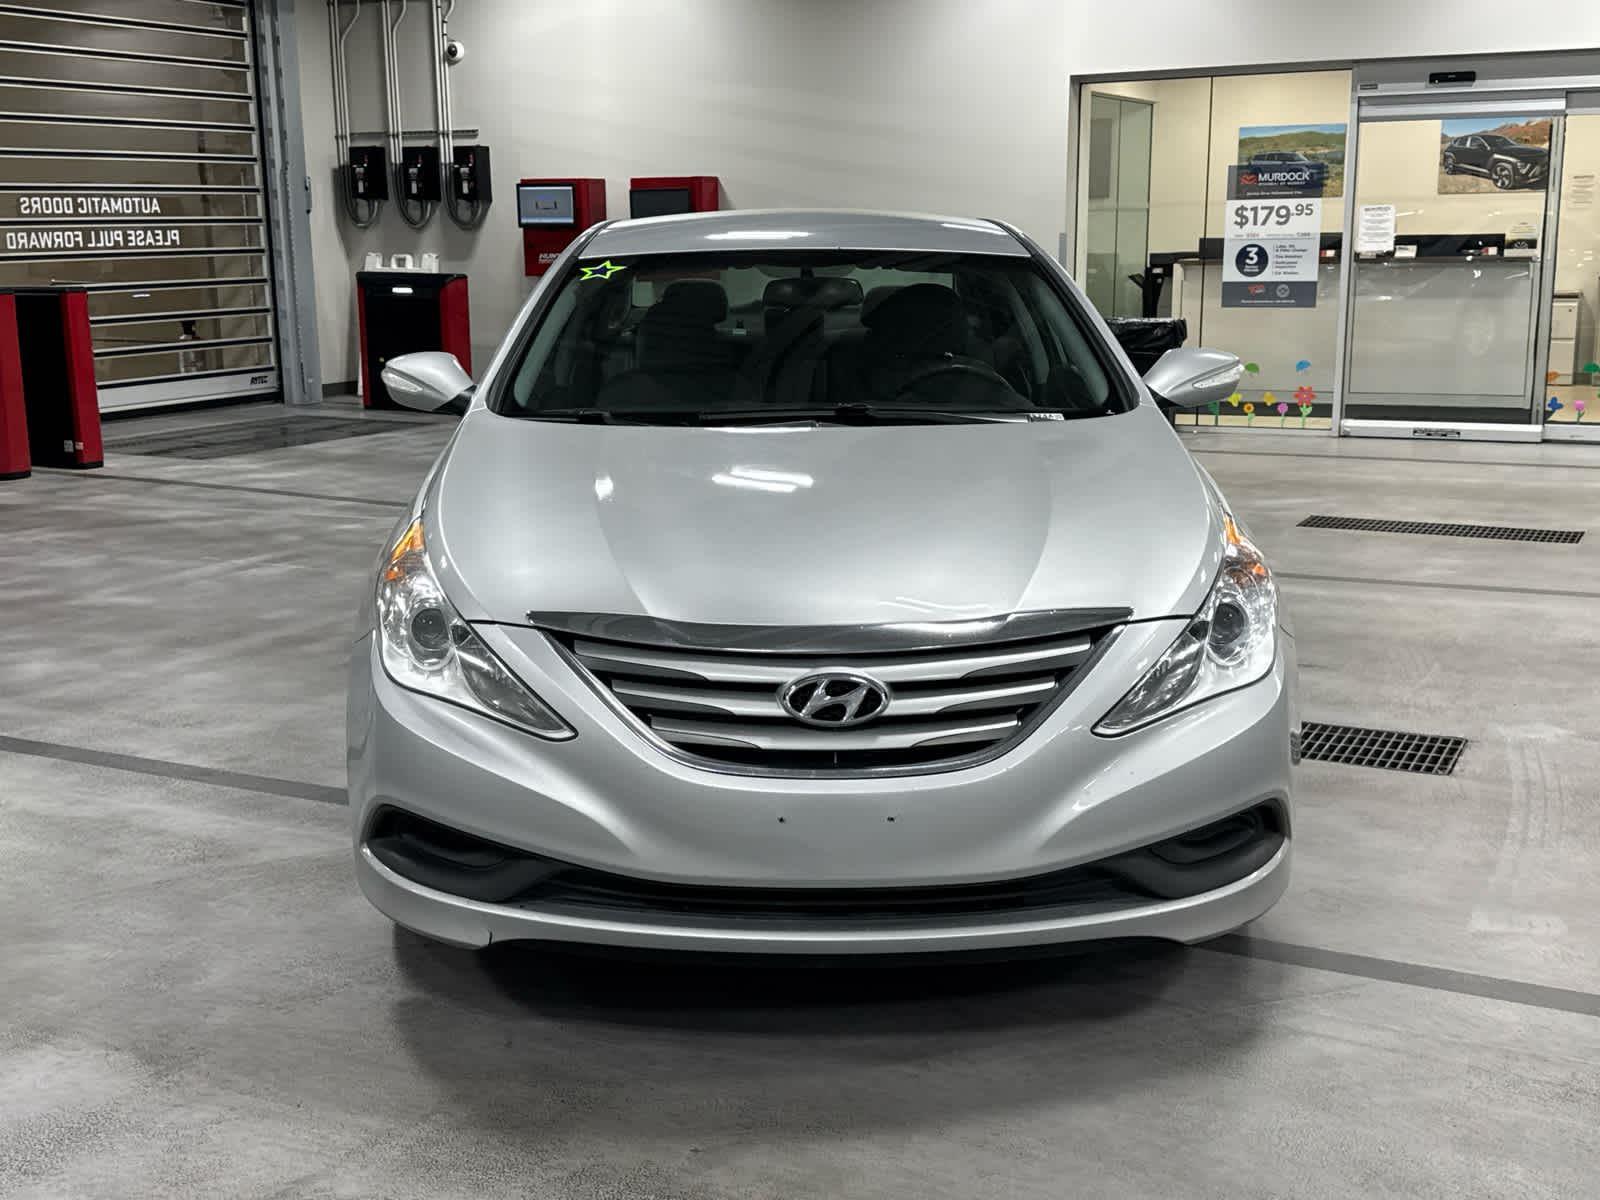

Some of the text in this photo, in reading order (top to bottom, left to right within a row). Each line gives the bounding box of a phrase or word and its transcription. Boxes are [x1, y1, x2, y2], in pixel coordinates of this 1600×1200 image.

[1258, 171, 1310, 182] MURDOCK
[1233, 203, 1314, 229] $179.95
[1244, 246, 1259, 265] 3
